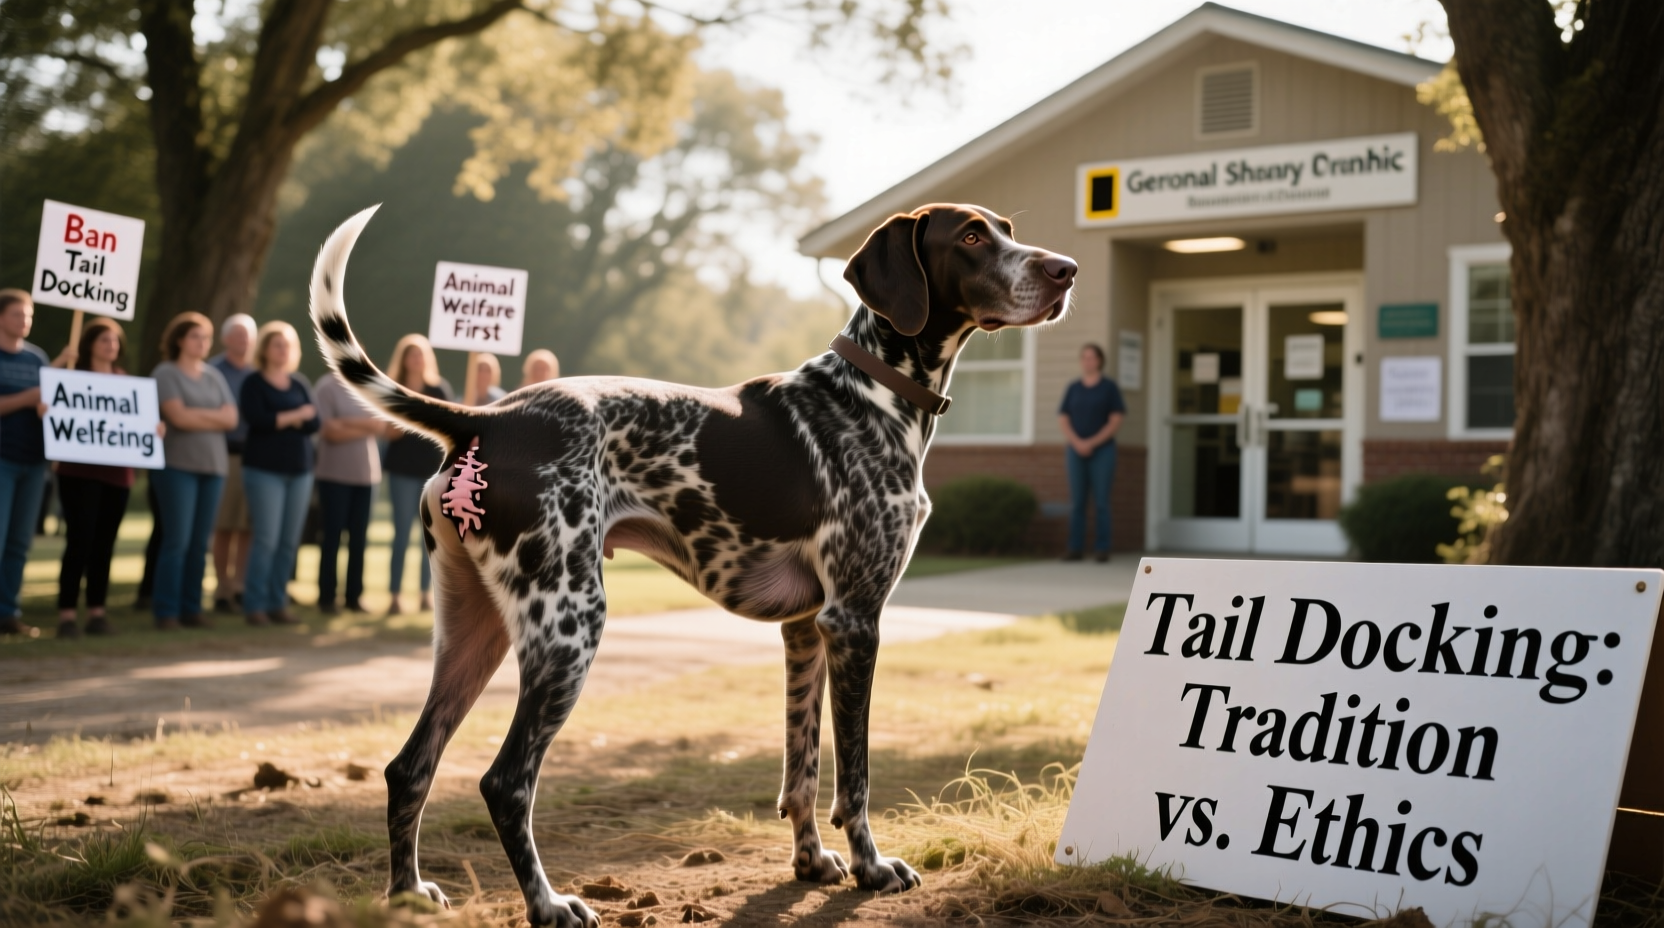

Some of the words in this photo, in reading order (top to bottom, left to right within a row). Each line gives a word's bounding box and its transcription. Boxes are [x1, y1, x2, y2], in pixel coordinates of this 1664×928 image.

[64, 213, 117, 252] Ban
[65, 249, 105, 275] Tail
[40, 269, 129, 311] Docking
[444, 272, 514, 296] Animal
[442, 296, 515, 319] Welfare
[453, 319, 501, 341] First
[52, 382, 139, 415] Animal
[1144, 592, 1265, 662] Tail
[1274, 597, 1621, 704] Docking:
[1179, 682, 1499, 781] Tradition
[1155, 791, 1230, 850] vs.
[1251, 784, 1484, 887] Ethics
